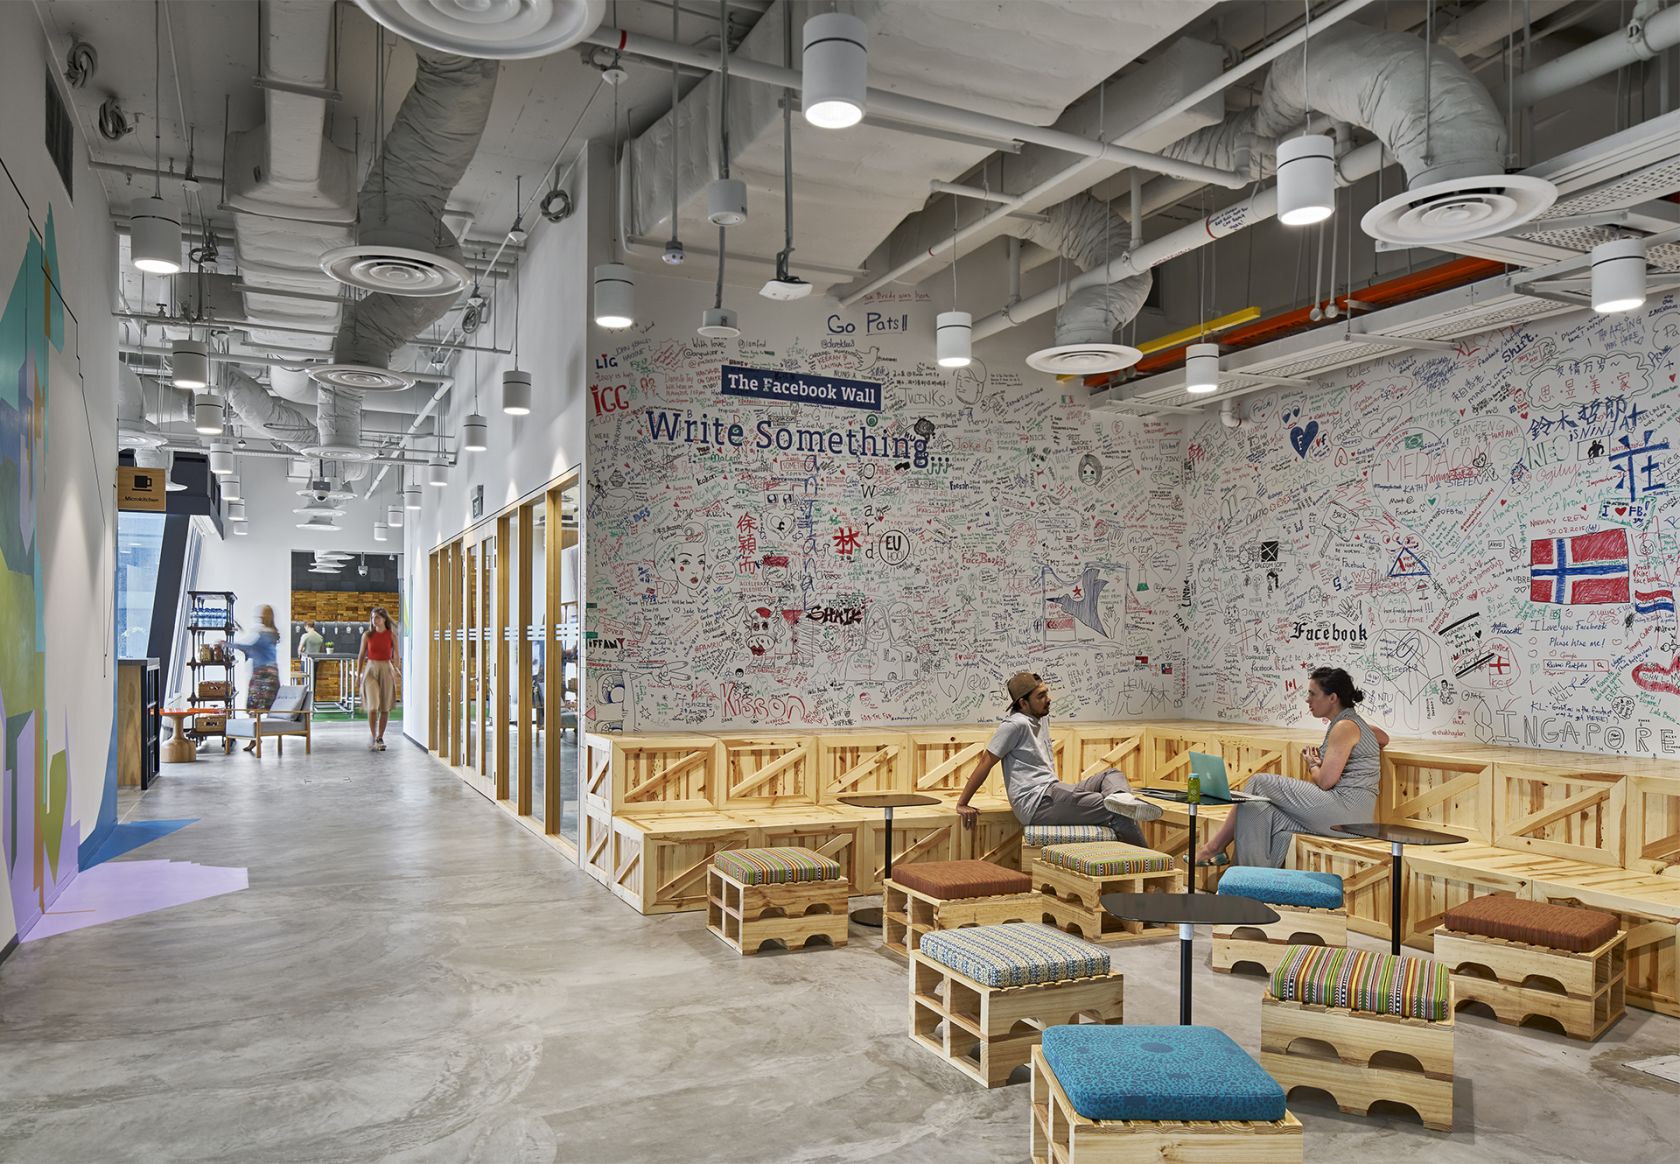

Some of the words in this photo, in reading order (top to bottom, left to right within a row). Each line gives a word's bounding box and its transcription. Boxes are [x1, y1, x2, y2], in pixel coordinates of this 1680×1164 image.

[827, 314, 855, 333] Go
[727, 374, 758, 391] The
[763, 377, 837, 400] Facebook
[841, 386, 876, 405] Wall
[646, 411, 744, 447] Write
[885, 535, 901, 551] EU
[1290, 621, 1369, 643] Facebook
